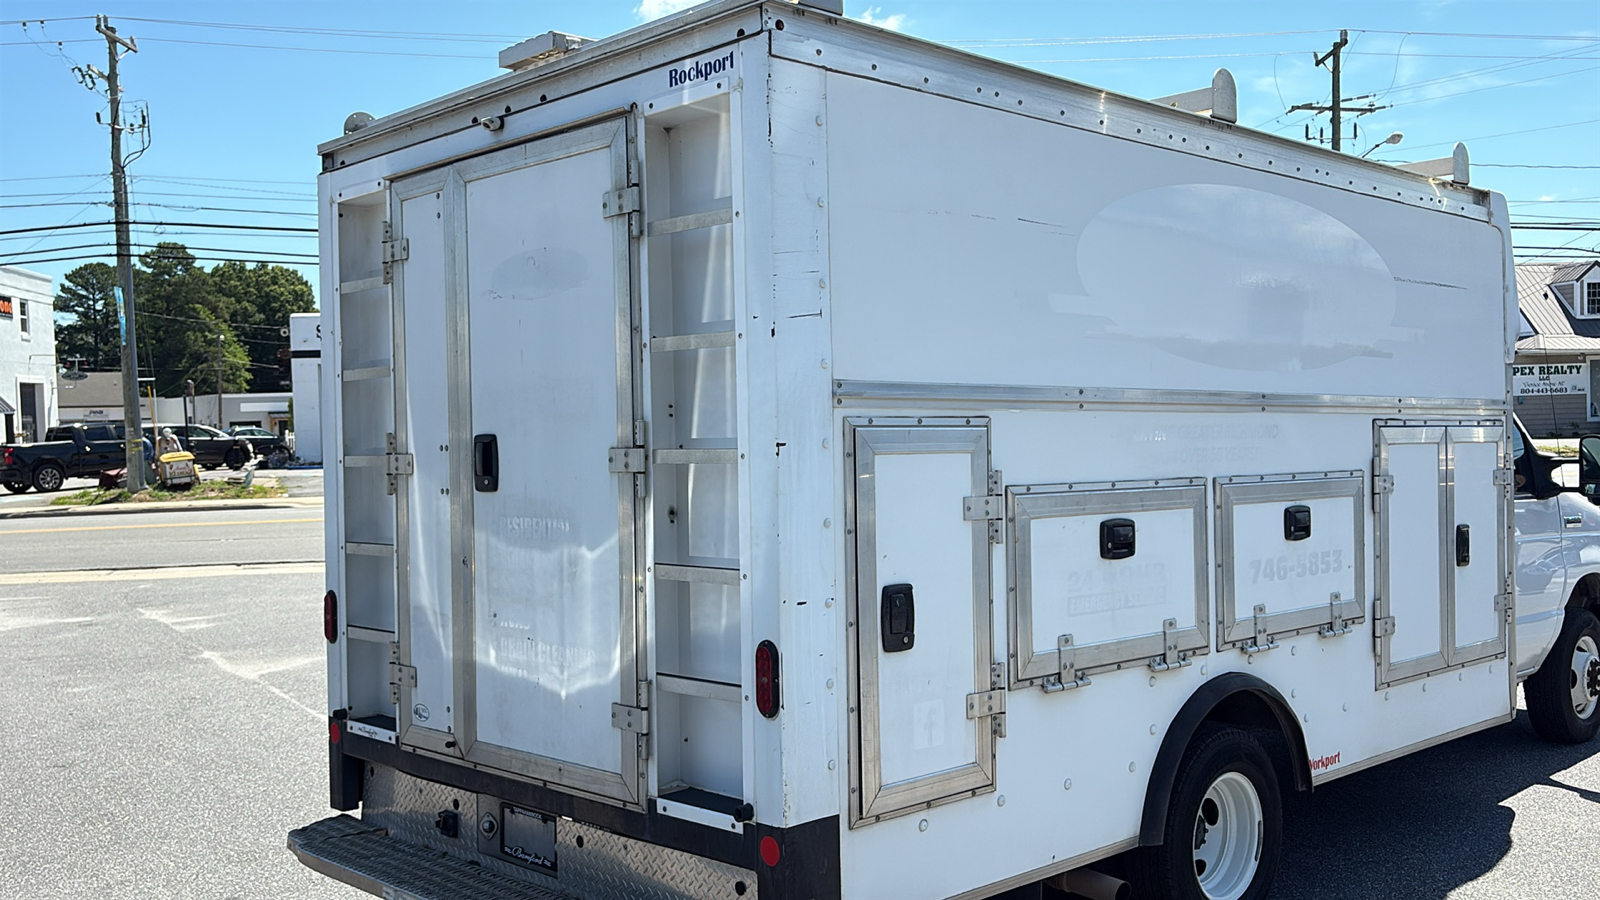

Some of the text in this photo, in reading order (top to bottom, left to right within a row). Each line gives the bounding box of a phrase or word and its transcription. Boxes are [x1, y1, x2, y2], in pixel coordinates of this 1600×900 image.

[669, 51, 734, 88] Rockport
[1538, 365, 1582, 375] REALTY
[1248, 549, 1342, 584] 746-5853
